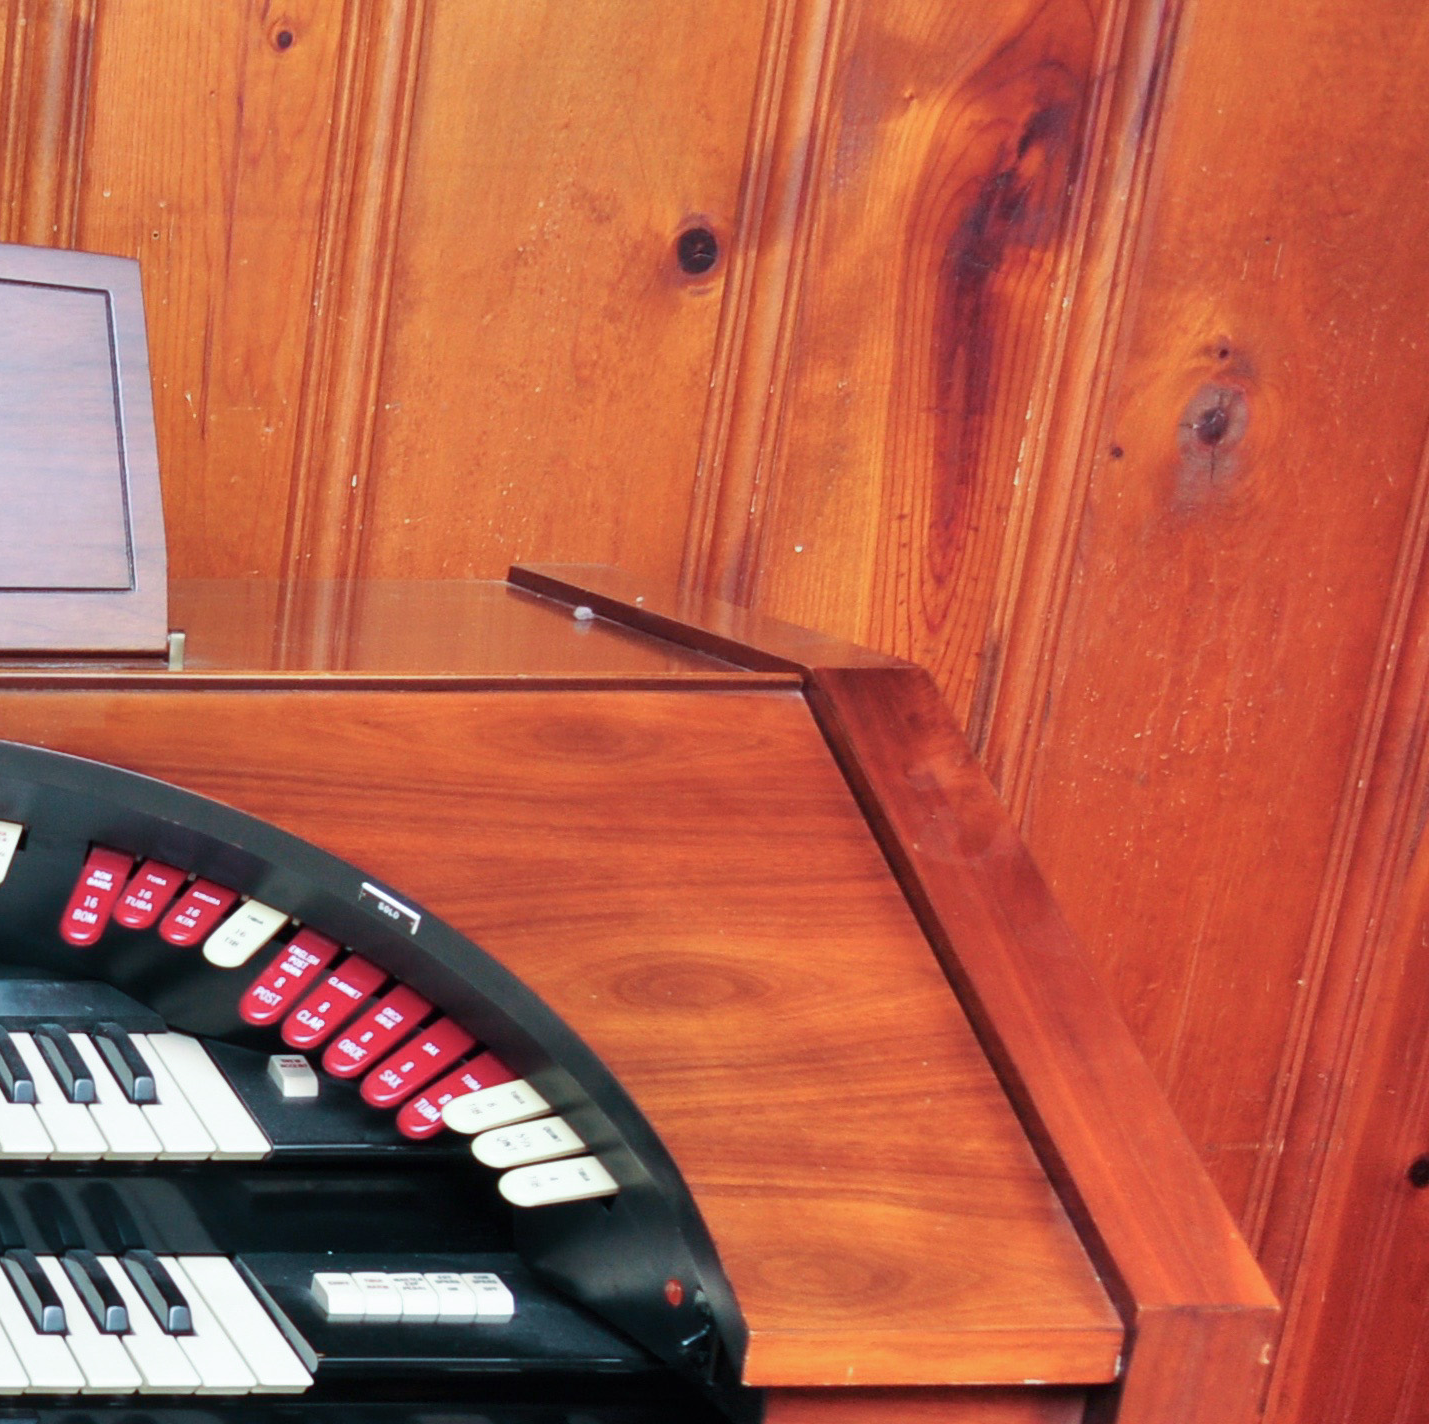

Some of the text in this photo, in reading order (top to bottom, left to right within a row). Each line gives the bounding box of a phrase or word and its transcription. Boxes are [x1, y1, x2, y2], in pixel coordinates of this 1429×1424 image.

[147, 874, 167, 886] TUBA
[137, 888, 152, 900] 16
[84, 895, 98, 908] 16
[125, 895, 153, 912] TUBA
[72, 909, 98, 924] BOM
[185, 906, 201, 918] 16
[377, 902, 399, 920] SOLO
[175, 914, 197, 928] KIN
[288, 945, 320, 966] ENGLISH
[274, 977, 286, 988] 8
[328, 976, 363, 1000] CLARINET
[252, 985, 283, 1007] POST
[318, 1001, 331, 1013] 8
[296, 1009, 325, 1031] CLAR
[360, 1031, 374, 1043] 8
[338, 1038, 367, 1061] OBOE
[422, 1042, 440, 1056] SAX
[400, 1061, 415, 1072] 8
[379, 1070, 403, 1089] SAX
[461, 1074, 482, 1090] TUBA
[438, 1094, 452, 1105] 8
[414, 1097, 441, 1122] TUBA
